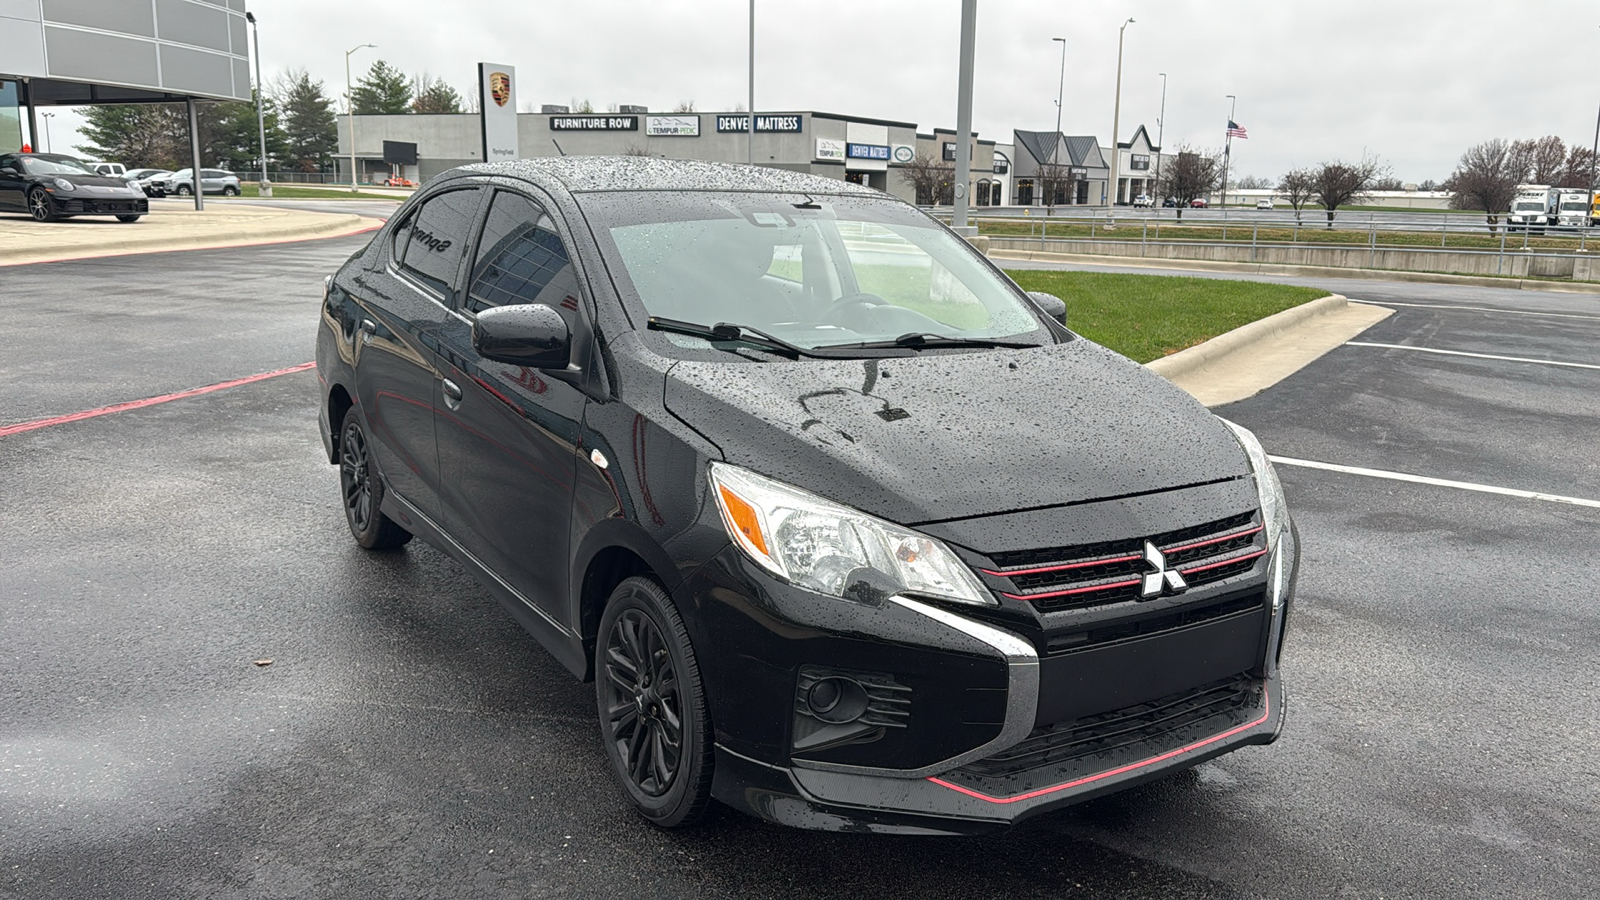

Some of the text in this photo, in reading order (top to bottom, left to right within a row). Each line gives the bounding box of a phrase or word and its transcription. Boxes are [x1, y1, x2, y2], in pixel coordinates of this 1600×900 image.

[553, 118, 632, 129] FURNITURE ROW
[719, 117, 798, 130] DENVE MATTRESS
